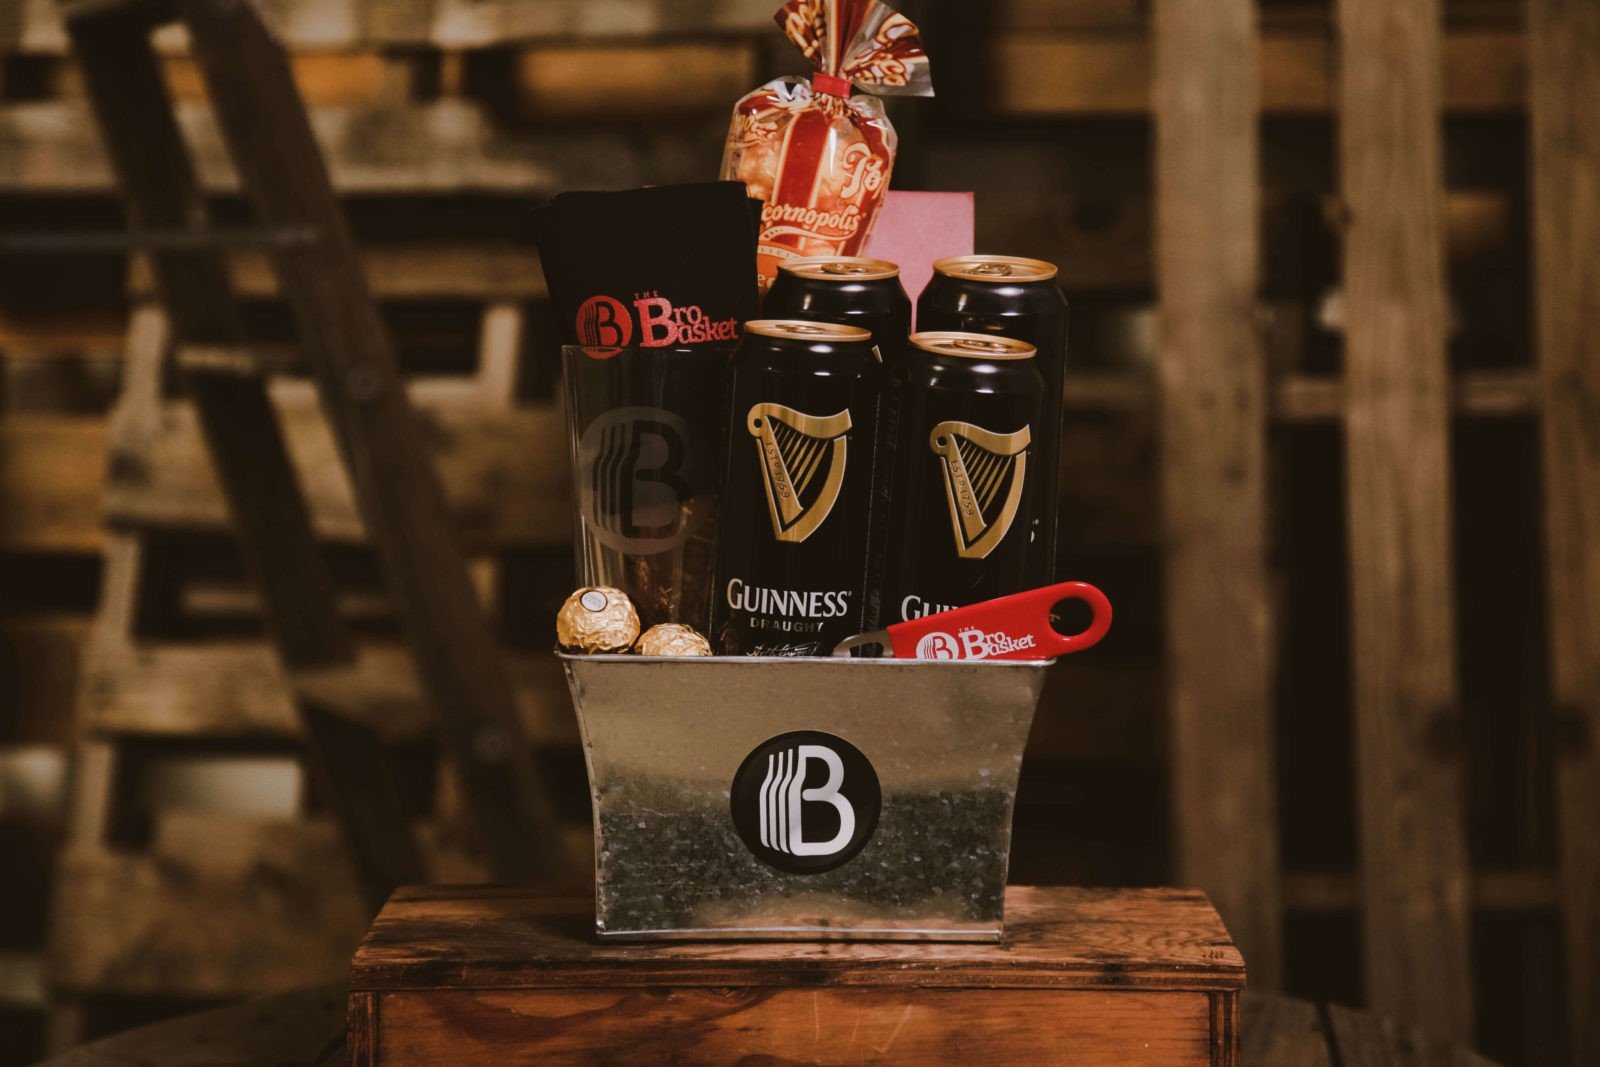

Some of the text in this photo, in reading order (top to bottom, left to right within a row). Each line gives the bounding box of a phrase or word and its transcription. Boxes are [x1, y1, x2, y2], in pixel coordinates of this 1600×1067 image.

[761, 203, 860, 232] cornopolis
[634, 290, 659, 299] THE
[727, 578, 848, 618] GUINNESS
[750, 617, 823, 632] DRAUGHT
